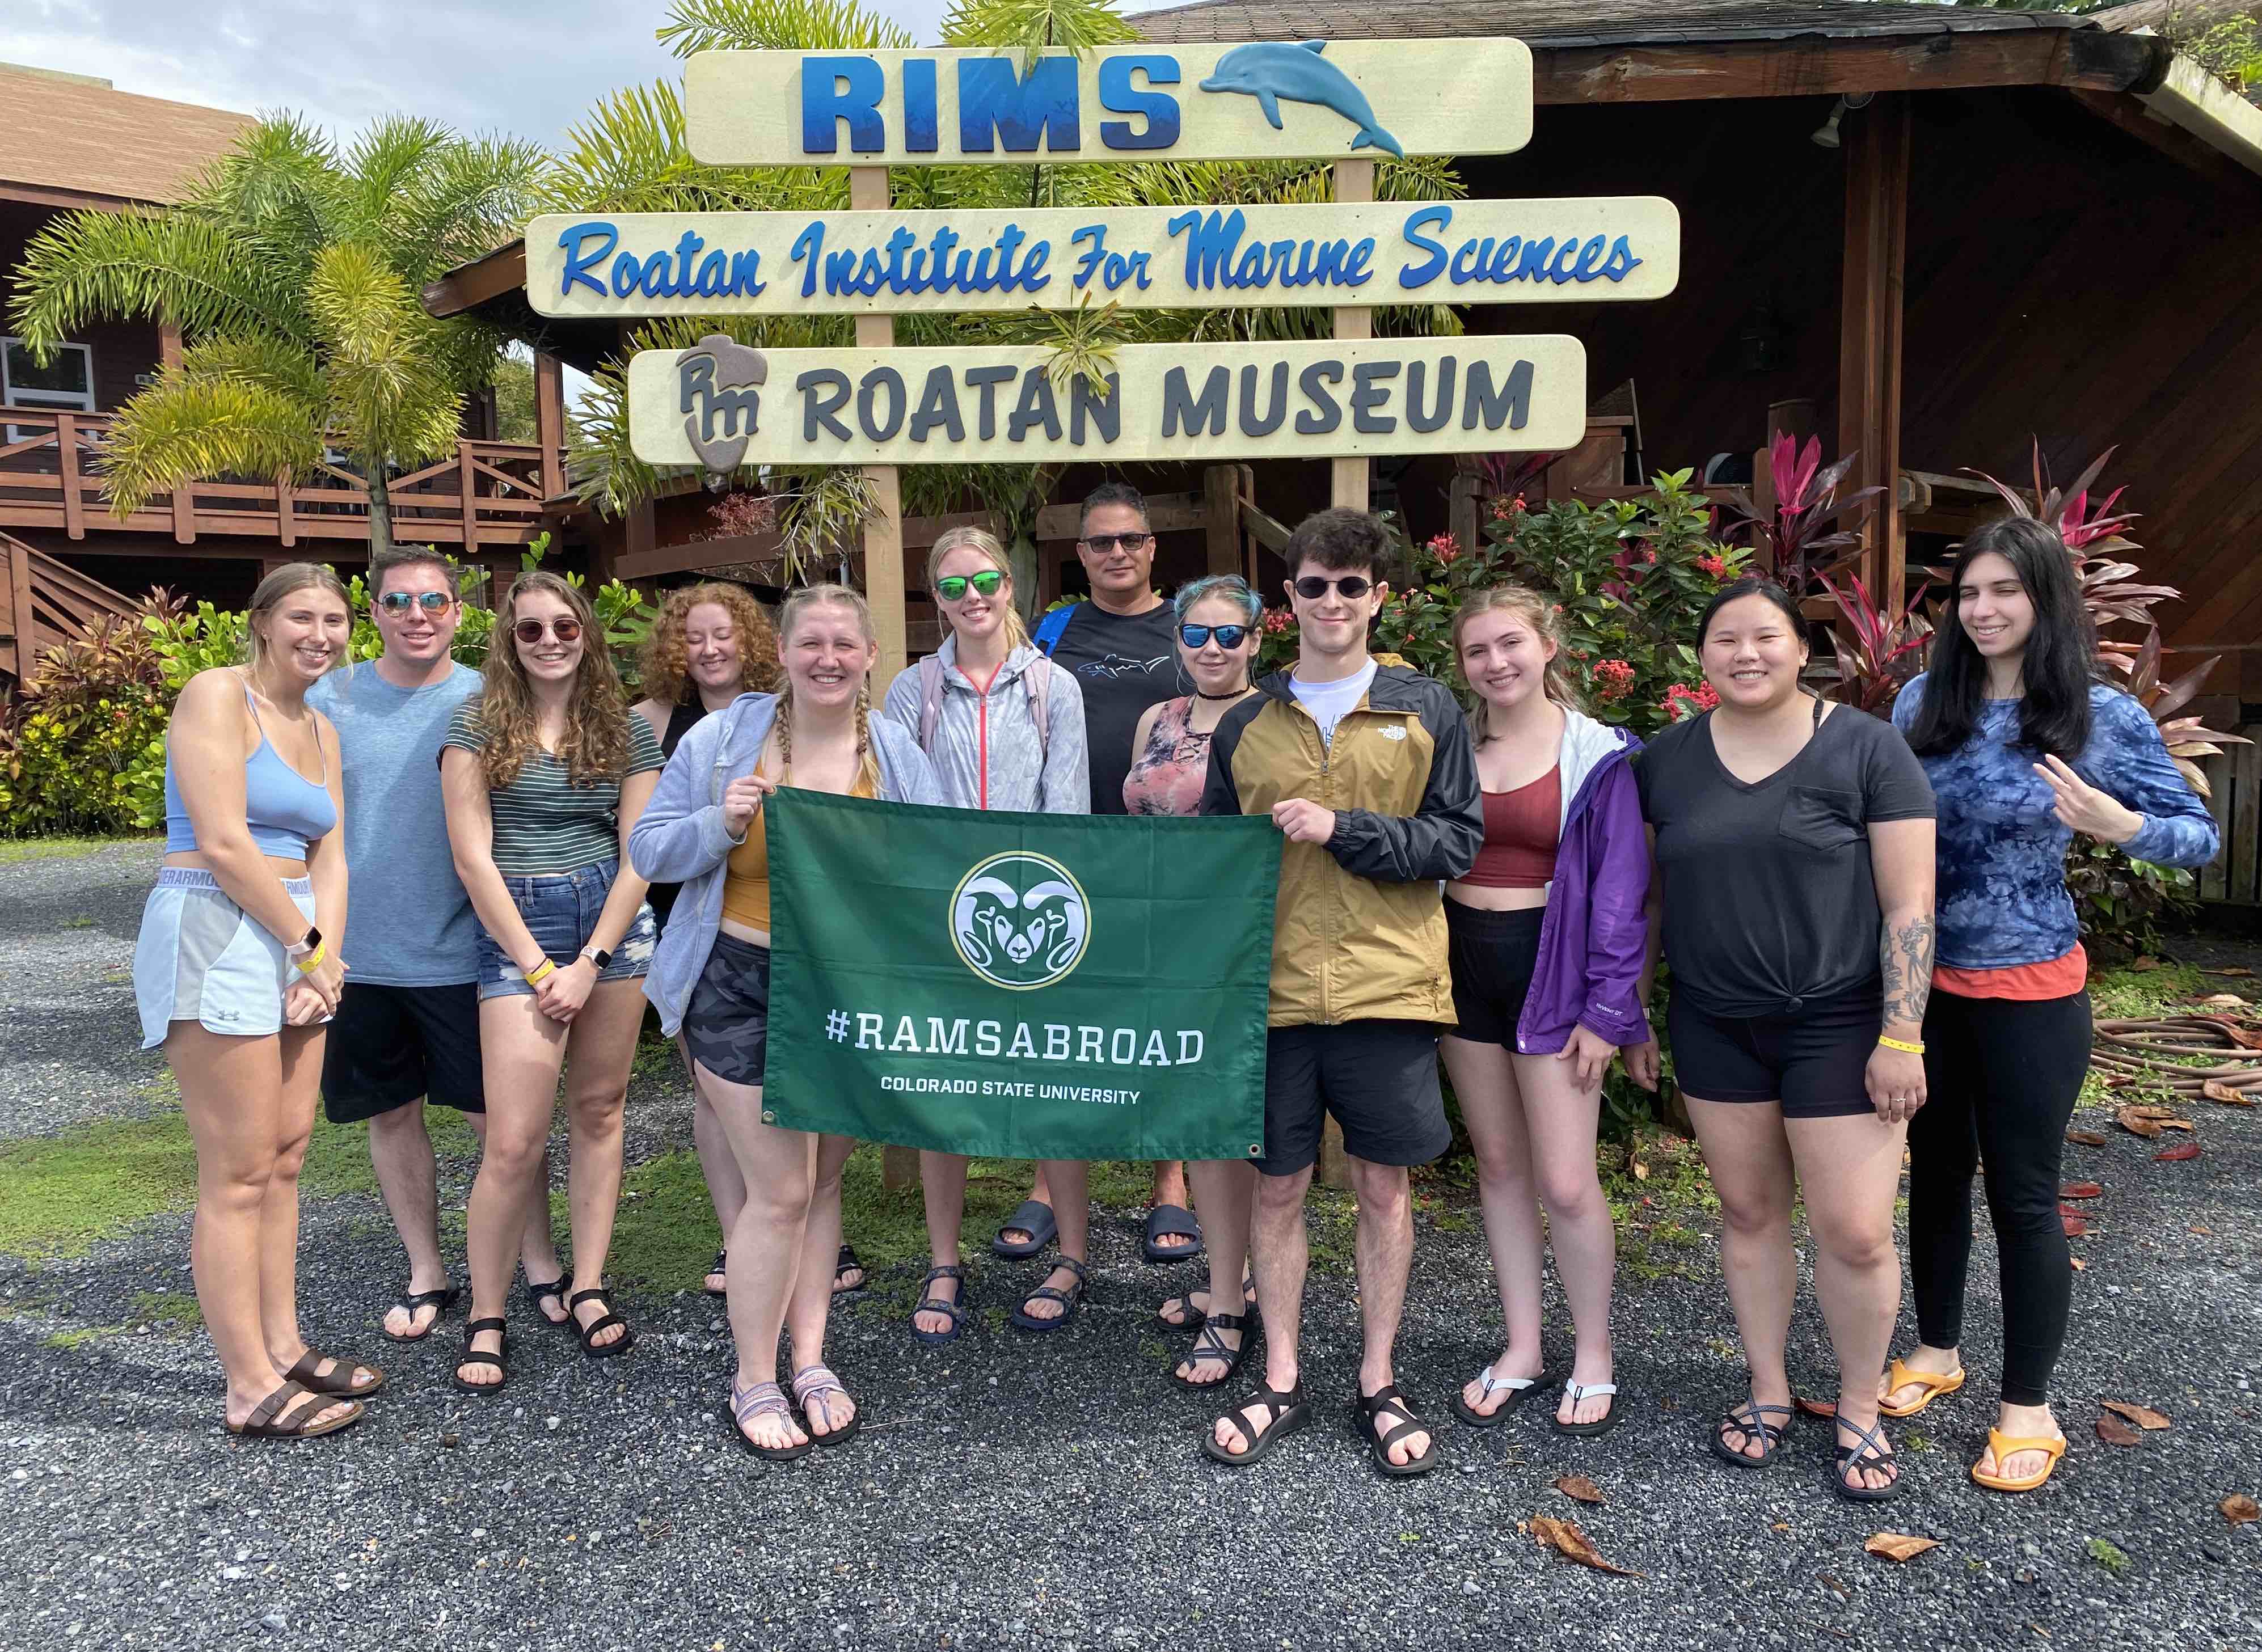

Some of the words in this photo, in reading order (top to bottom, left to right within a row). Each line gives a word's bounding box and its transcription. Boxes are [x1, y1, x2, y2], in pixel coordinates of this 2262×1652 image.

[802, 55, 1181, 152] RIMS
[558, 221, 767, 298] Roatan
[791, 221, 1052, 298] Institute
[1071, 224, 1153, 291] For
[1168, 208, 1374, 290] Marine
[1399, 205, 1644, 289] Sciences
[796, 364, 1121, 446] ROATAN
[1161, 355, 1535, 437] MUSEUM
[825, 1008, 1204, 1066] #RAMSABROAD
[881, 1076, 977, 1094] COLORADO
[982, 1081, 1034, 1097] STATE
[1039, 1084, 1141, 1105] UNIVERSITY
